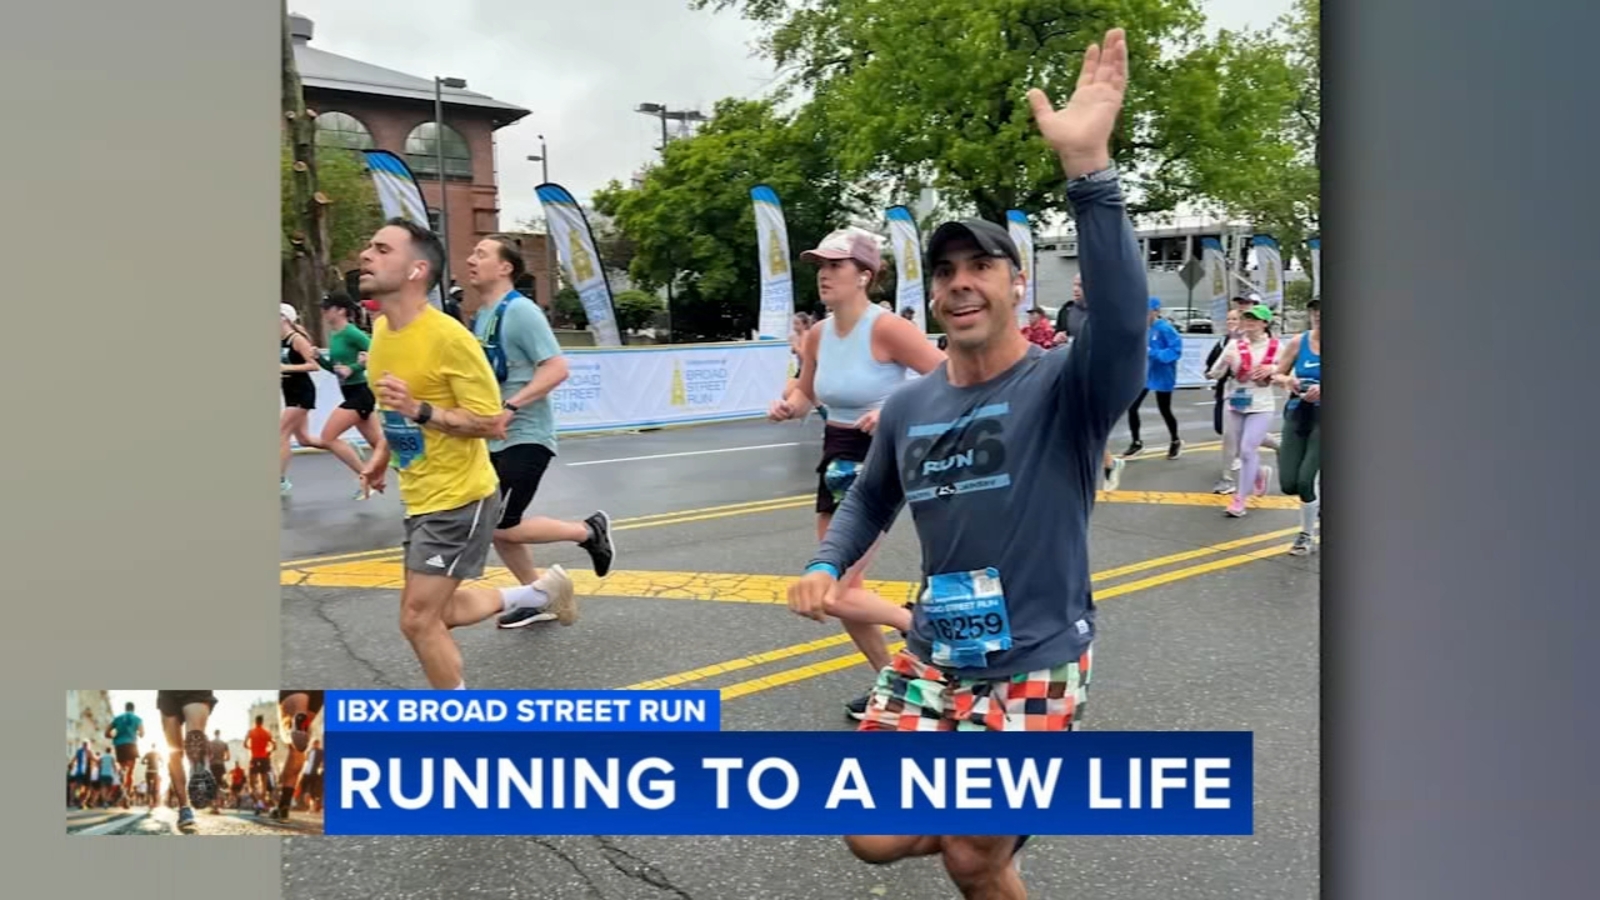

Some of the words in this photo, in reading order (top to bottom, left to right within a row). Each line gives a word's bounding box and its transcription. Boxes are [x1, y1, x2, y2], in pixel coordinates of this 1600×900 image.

[686, 368, 727, 380] BROAD
[687, 380, 727, 392] STREET
[553, 387, 601, 400] STREET
[688, 394, 713, 404] RUN
[553, 402, 584, 412] RUN
[922, 448, 974, 476] RUN
